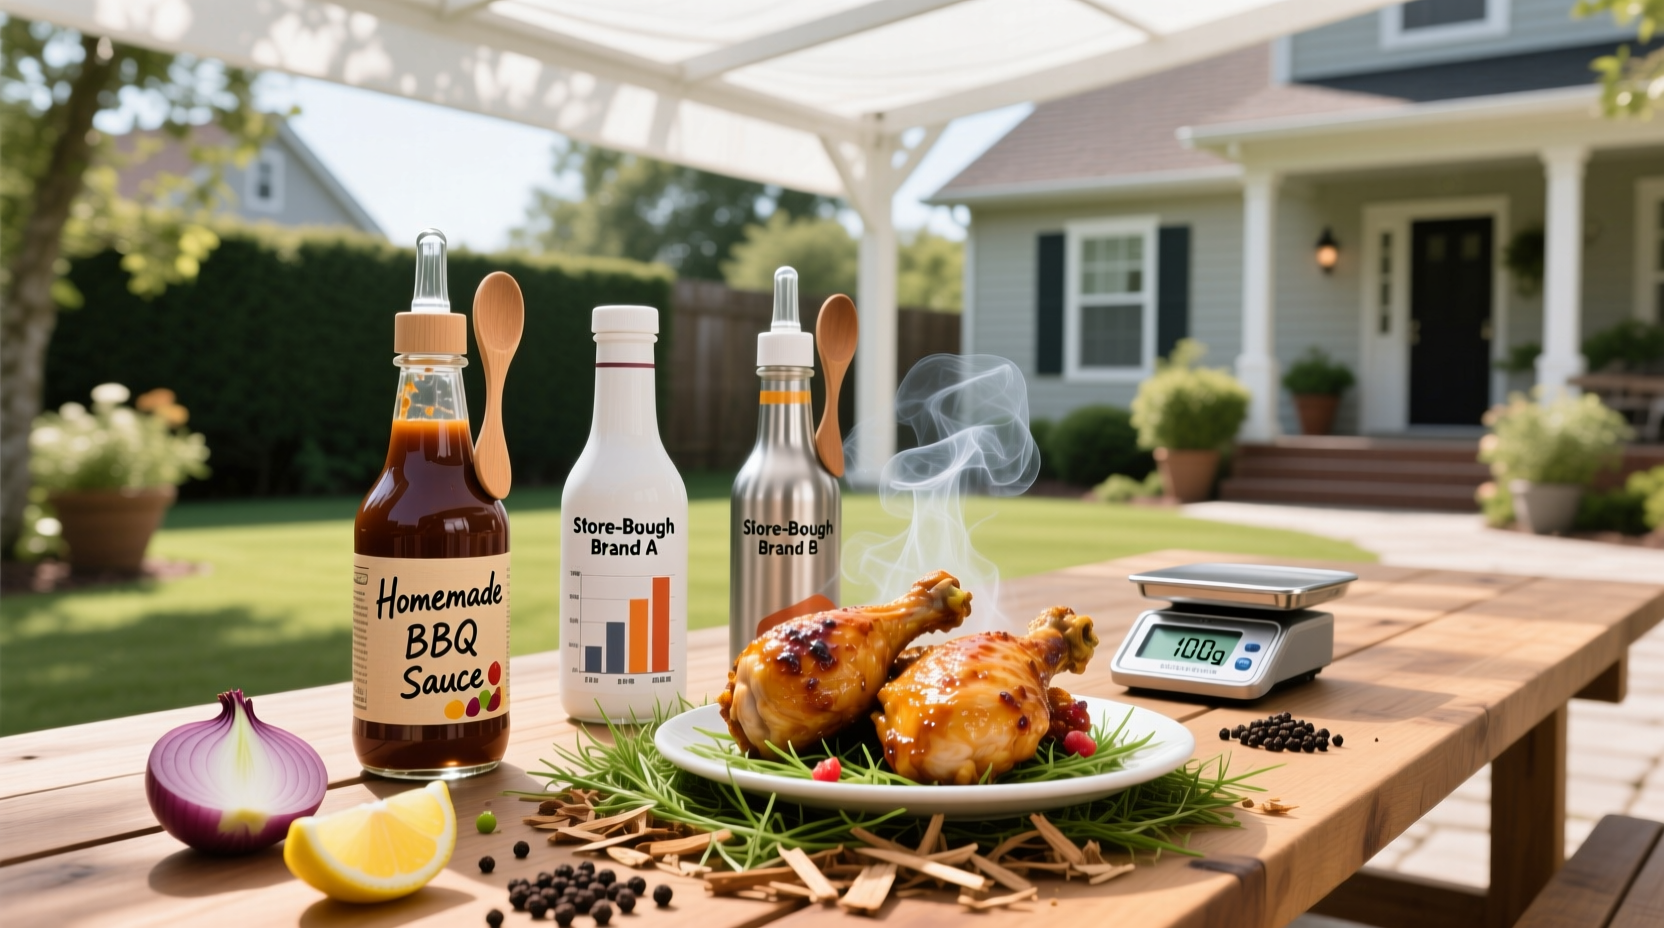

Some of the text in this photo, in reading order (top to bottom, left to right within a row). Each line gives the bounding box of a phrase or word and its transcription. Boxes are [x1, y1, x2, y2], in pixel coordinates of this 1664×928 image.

[573, 516, 675, 539] Store-Bough
[591, 538, 658, 556] Brand A
[758, 540, 819, 555] Brand B
[376, 570, 503, 620] Homemade
[405, 618, 478, 660] BBQ
[1173, 637, 1226, 666] 100g
[400, 665, 484, 699] Sauce
